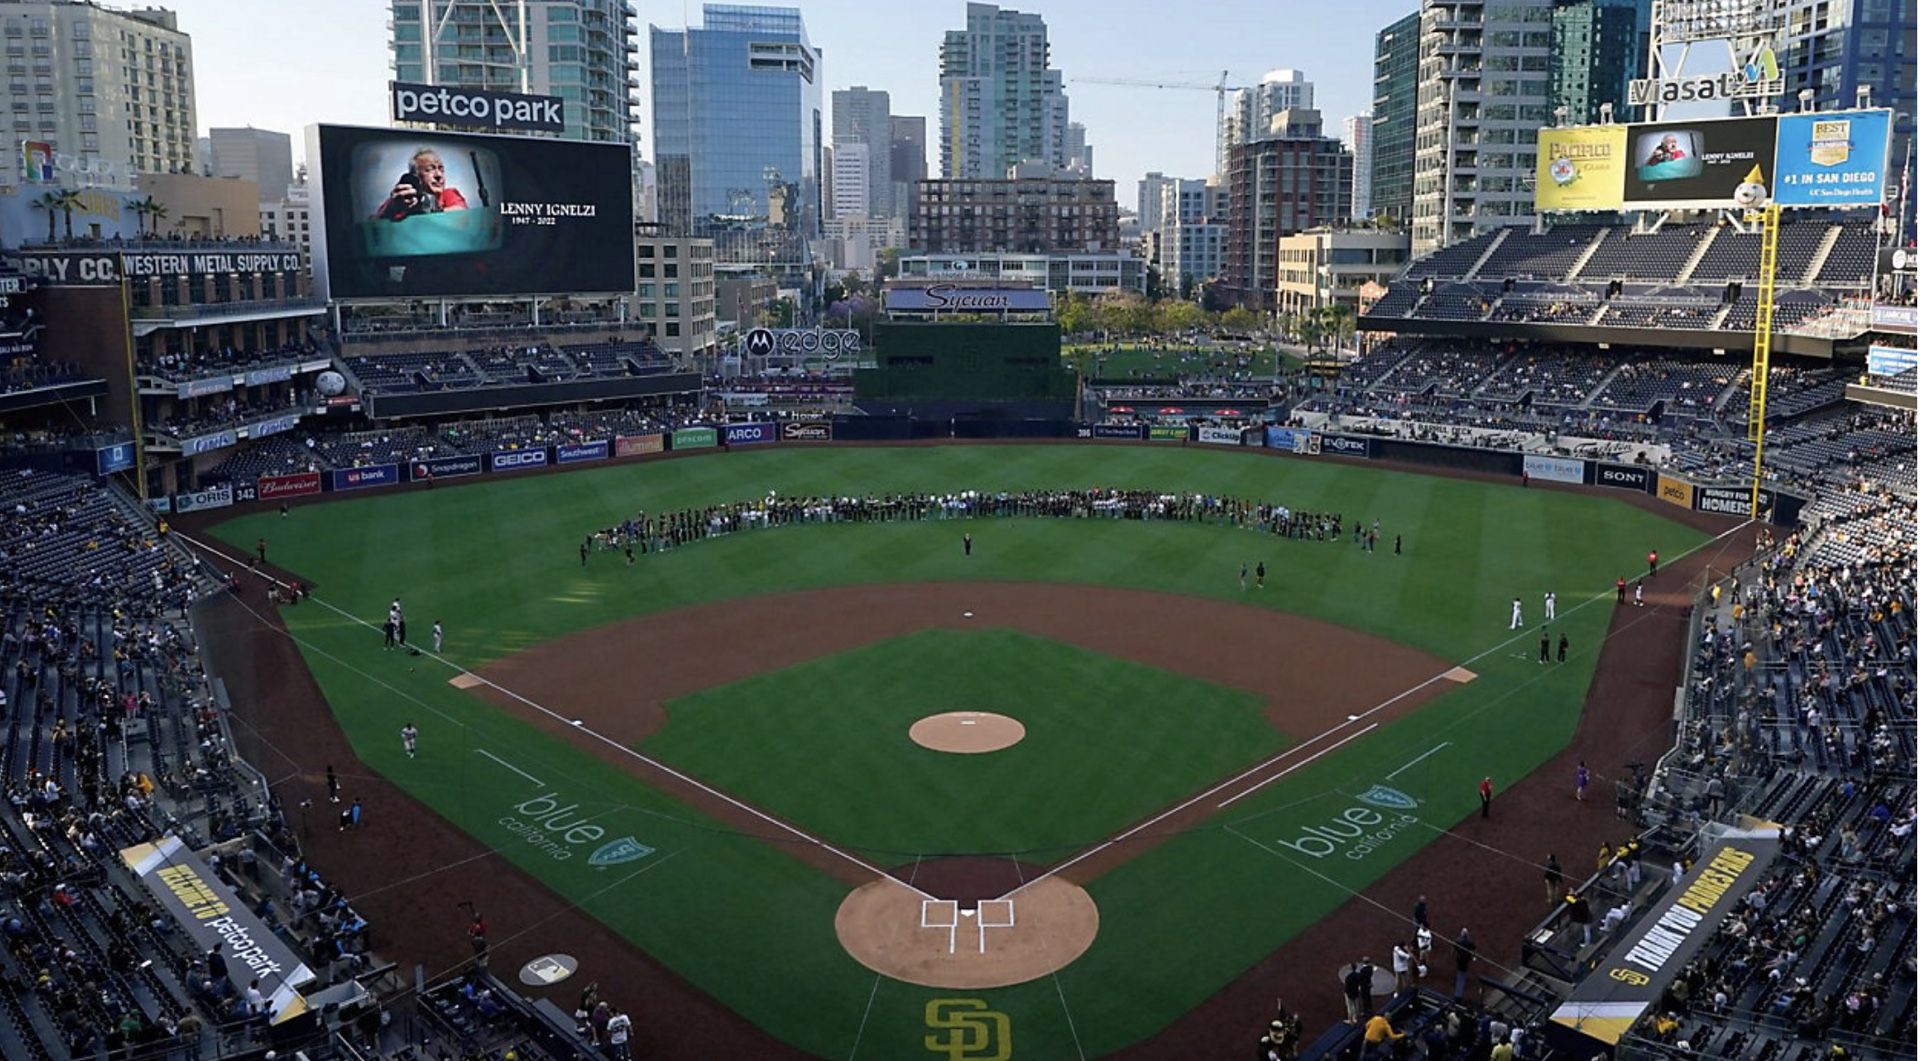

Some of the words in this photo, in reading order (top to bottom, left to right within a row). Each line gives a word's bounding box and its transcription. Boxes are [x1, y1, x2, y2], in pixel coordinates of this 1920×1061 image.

[1632, 73, 1732, 103] Viasat
[397, 89, 489, 118] petco
[494, 98, 561, 125] park
[1816, 123, 1847, 133] BEST
[1784, 174, 1797, 184] #1
[1801, 174, 1813, 184] IN
[1817, 173, 1839, 183] SAN
[1843, 172, 1875, 183] DIEGO
[500, 202, 543, 215] LENNY
[546, 202, 595, 216] IGNELZI
[79, 257, 121, 281] CO.
[123, 255, 189, 275] WESTERN
[194, 255, 235, 273] METAL
[237, 255, 279, 273] SUPPLY
[283, 255, 301, 271] CO.
[925, 283, 1008, 313] Sycuan
[782, 324, 860, 360] edge
[729, 428, 761, 440] ARCO
[1212, 431, 1239, 441] ClickUp
[431, 461, 477, 473] Snapdragon
[494, 452, 545, 467] GEICO
[262, 479, 318, 493] Budweiser
[348, 474, 359, 482] us
[361, 469, 384, 480] bank
[1603, 470, 1644, 483] SONY
[196, 490, 230, 504] ORIS
[236, 488, 254, 500] 342
[1735, 491, 1750, 500] FOR
[1702, 498, 1752, 515] HOMERS
[513, 792, 605, 843] blue
[499, 816, 571, 860] california
[1278, 807, 1382, 858] blue
[1345, 815, 1417, 860] california
[156, 863, 220, 908] WELCOME
[191, 902, 230, 919] TO
[1677, 868, 1735, 914] PADRES
[1658, 904, 1703, 934] YOU
[204, 916, 254, 950] petco
[232, 945, 282, 978] park
[1624, 924, 1686, 972] THANK
[925, 998, 1012, 1061] SD
